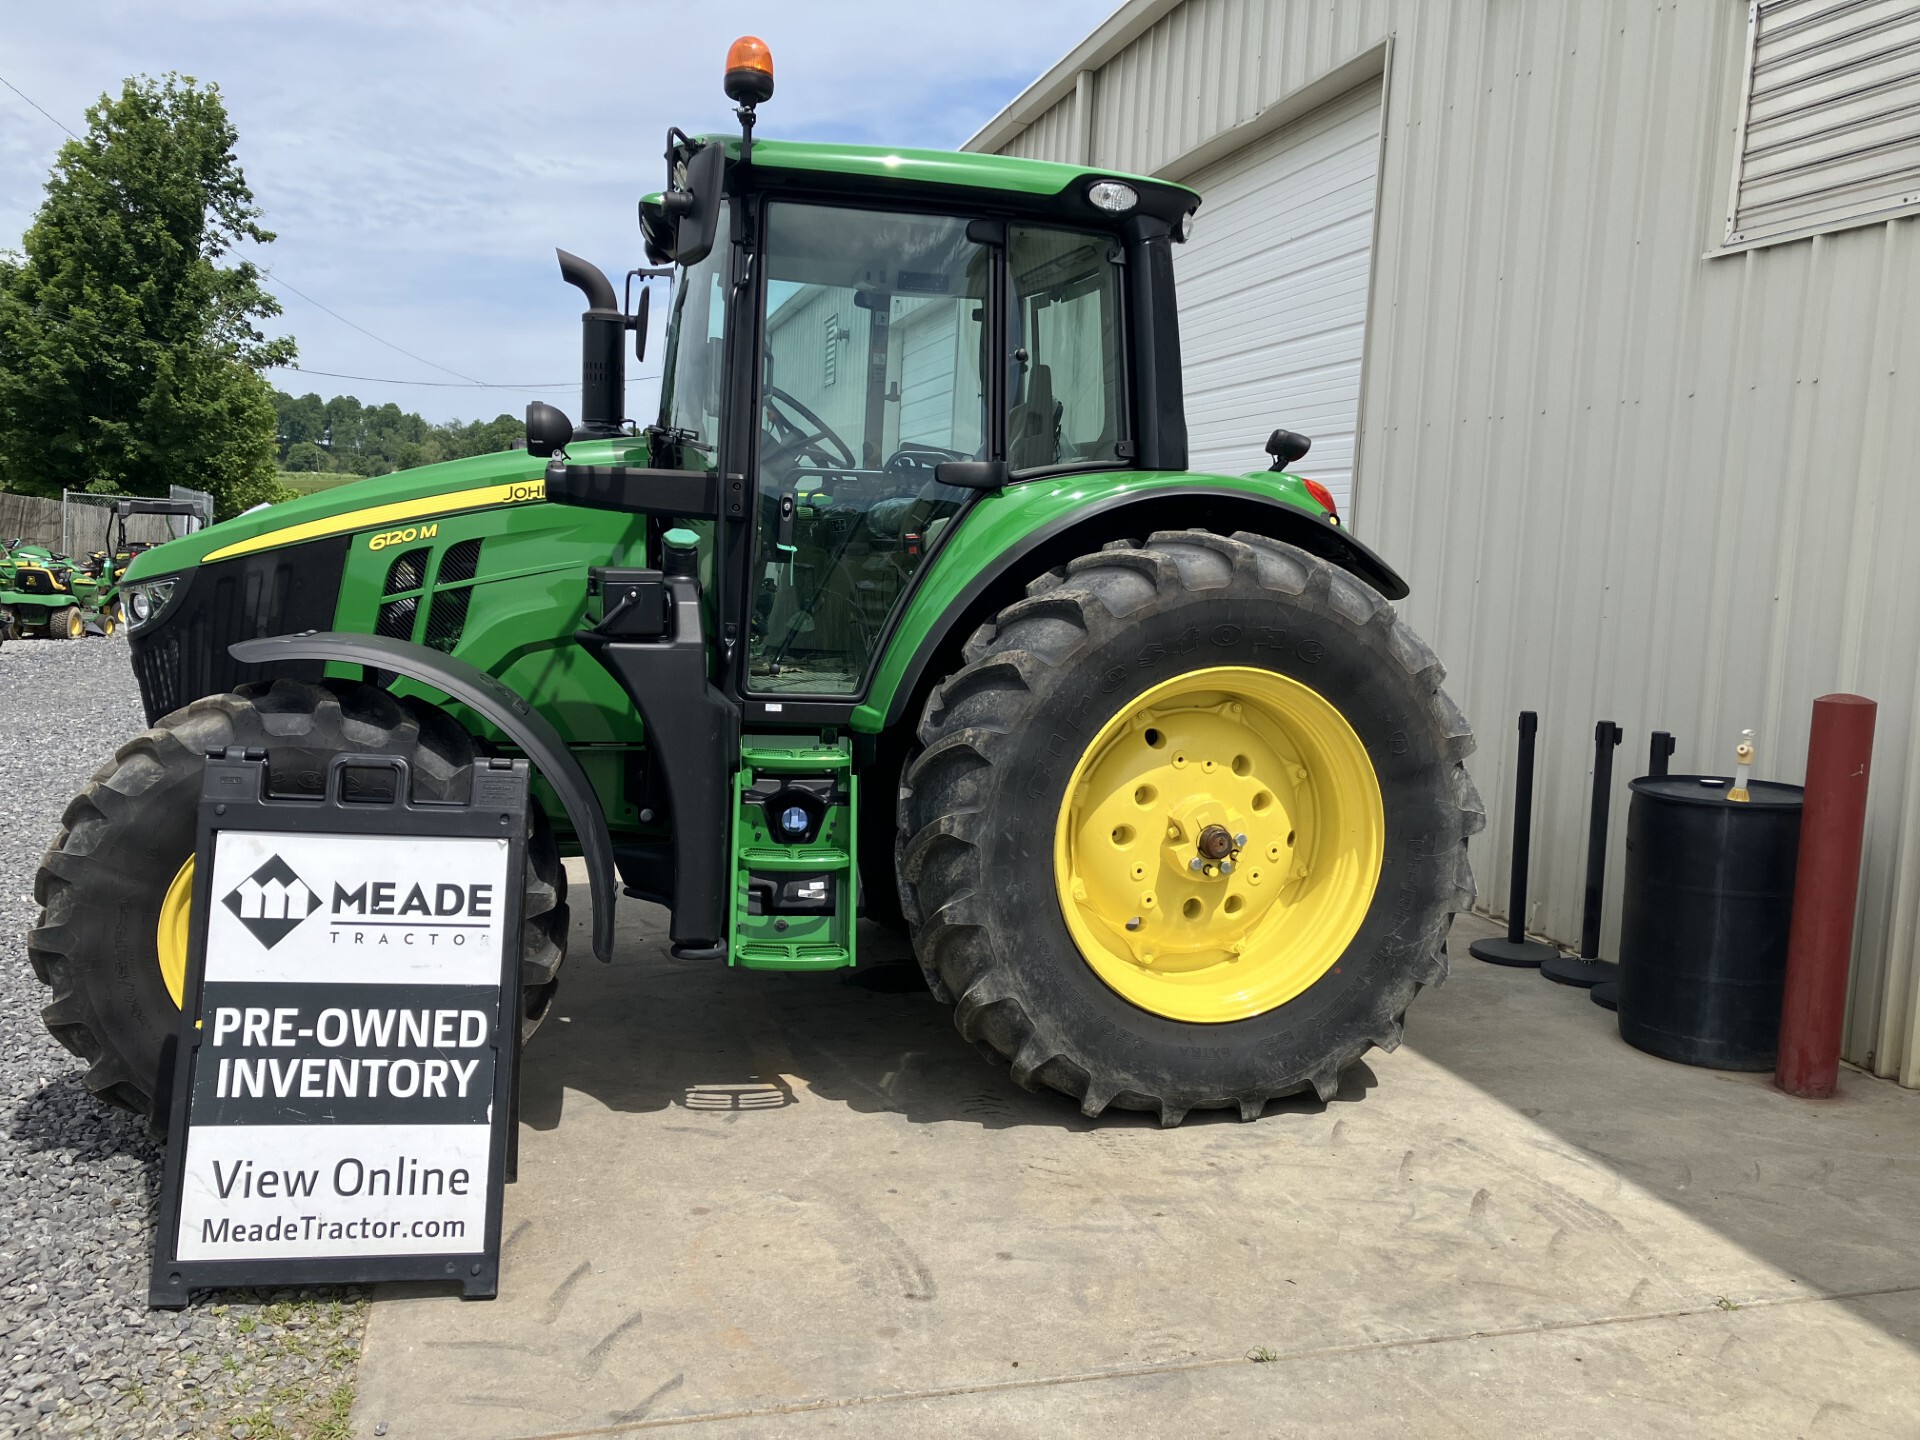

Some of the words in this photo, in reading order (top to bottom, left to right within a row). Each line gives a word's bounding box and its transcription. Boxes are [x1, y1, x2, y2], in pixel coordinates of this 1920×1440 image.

[368, 527, 418, 551] 6120
[419, 523, 439, 539] M
[331, 880, 493, 917] MEADE
[329, 931, 490, 947] TRACTO
[212, 1006, 488, 1048] PRE-OWNED
[216, 1058, 480, 1098] INVENTORY
[212, 1160, 320, 1199] View
[332, 1156, 470, 1197] Online
[201, 1215, 466, 1243] MeadeTractor.com
